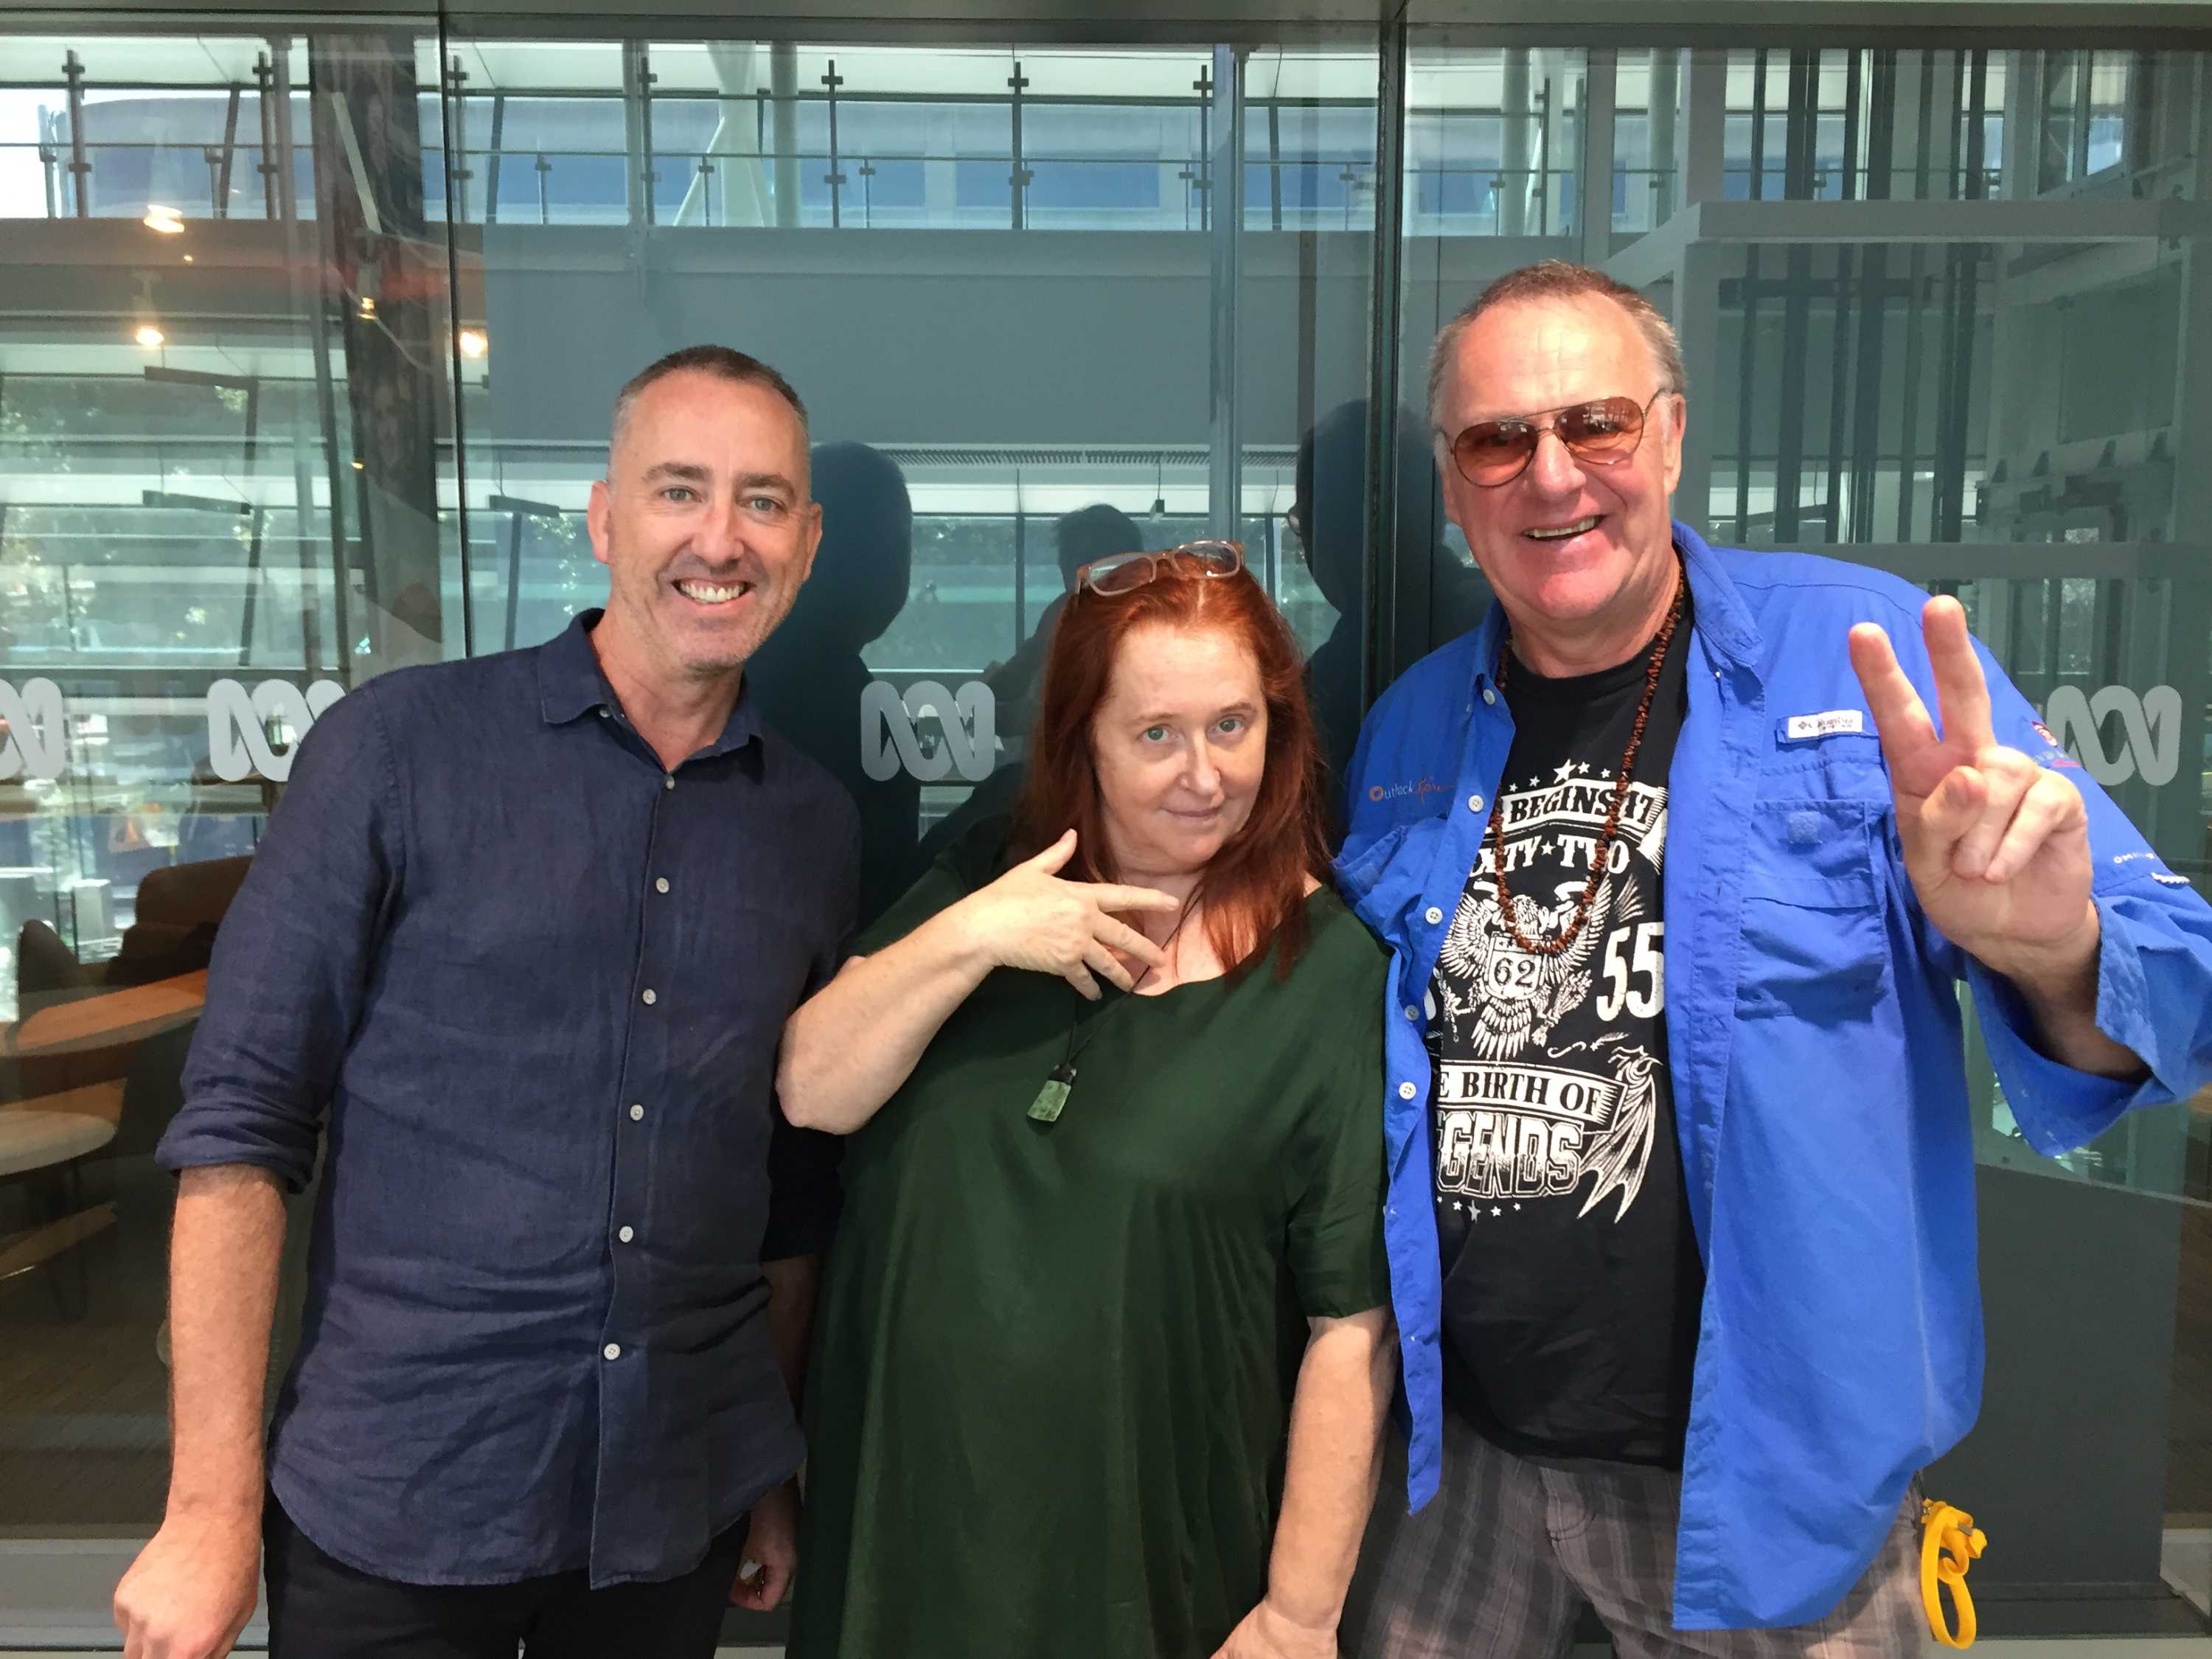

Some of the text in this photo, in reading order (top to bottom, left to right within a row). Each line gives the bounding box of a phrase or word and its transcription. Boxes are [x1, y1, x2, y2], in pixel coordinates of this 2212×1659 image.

[1508, 786, 1615, 825] BEGINS
[1470, 835, 1543, 877] XTY
[1494, 957, 1535, 988] 62
[1596, 921, 1665, 1022] 55
[1461, 1071, 1552, 1106] BIRTH
[1559, 1082, 1602, 1116] OF
[1436, 1110, 1585, 1200] GENDS
